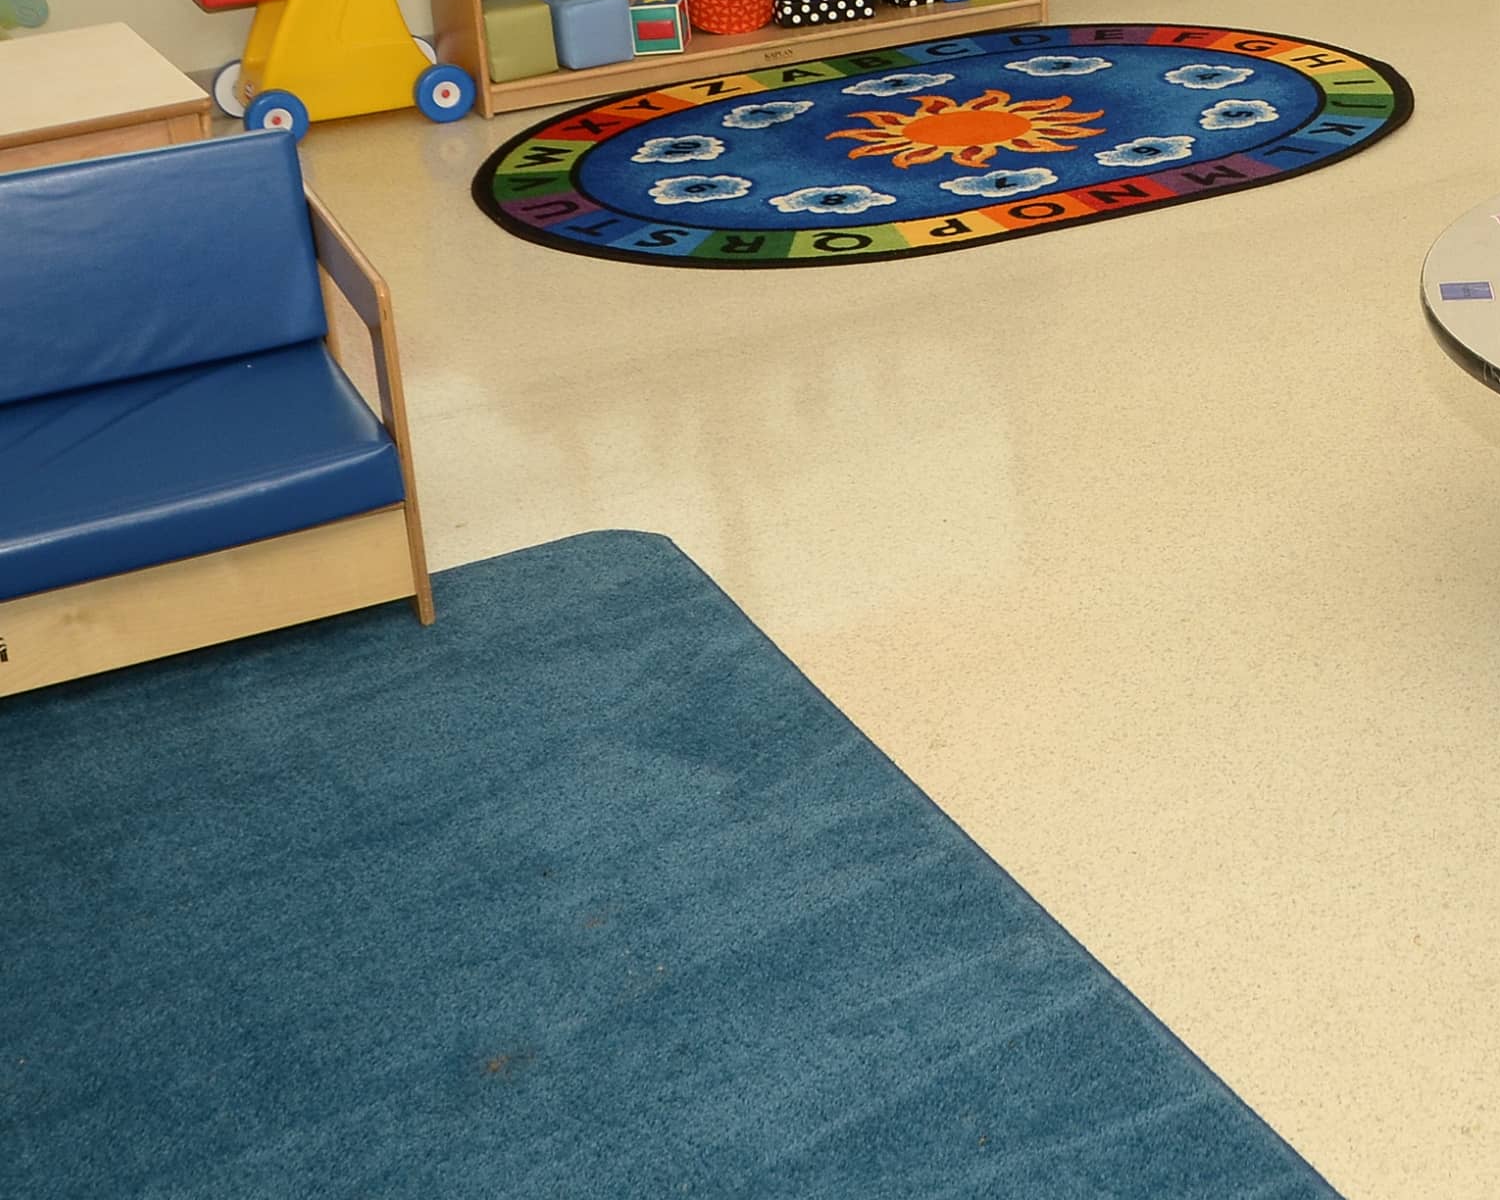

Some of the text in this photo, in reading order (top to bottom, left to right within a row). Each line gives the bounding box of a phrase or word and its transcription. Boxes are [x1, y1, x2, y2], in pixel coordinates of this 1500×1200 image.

[1009, 33, 1052, 46] D
[1094, 29, 1125, 41] E
[1173, 32, 1210, 43] F
[925, 43, 969, 56] C
[1233, 39, 1278, 52] G
[854, 57, 893, 68] B
[1290, 53, 1347, 68] H
[782, 68, 825, 83] A
[691, 81, 742, 96] Z
[616, 98, 664, 111] Y
[1331, 100, 1387, 109] J
[561, 118, 622, 135] X
[1307, 122, 1365, 137] K
[516, 146, 573, 169] W
[1263, 145, 1319, 156] L
[1180, 164, 1248, 186] M
[508, 177, 558, 192] V
[1087, 183, 1152, 204] N
[522, 201, 580, 220] U
[1008, 201, 1066, 220] O
[565, 218, 619, 236] T
[929, 218, 973, 238] P
[634, 229, 690, 248] S
[720, 235, 765, 254] R
[812, 232, 873, 252] Q
